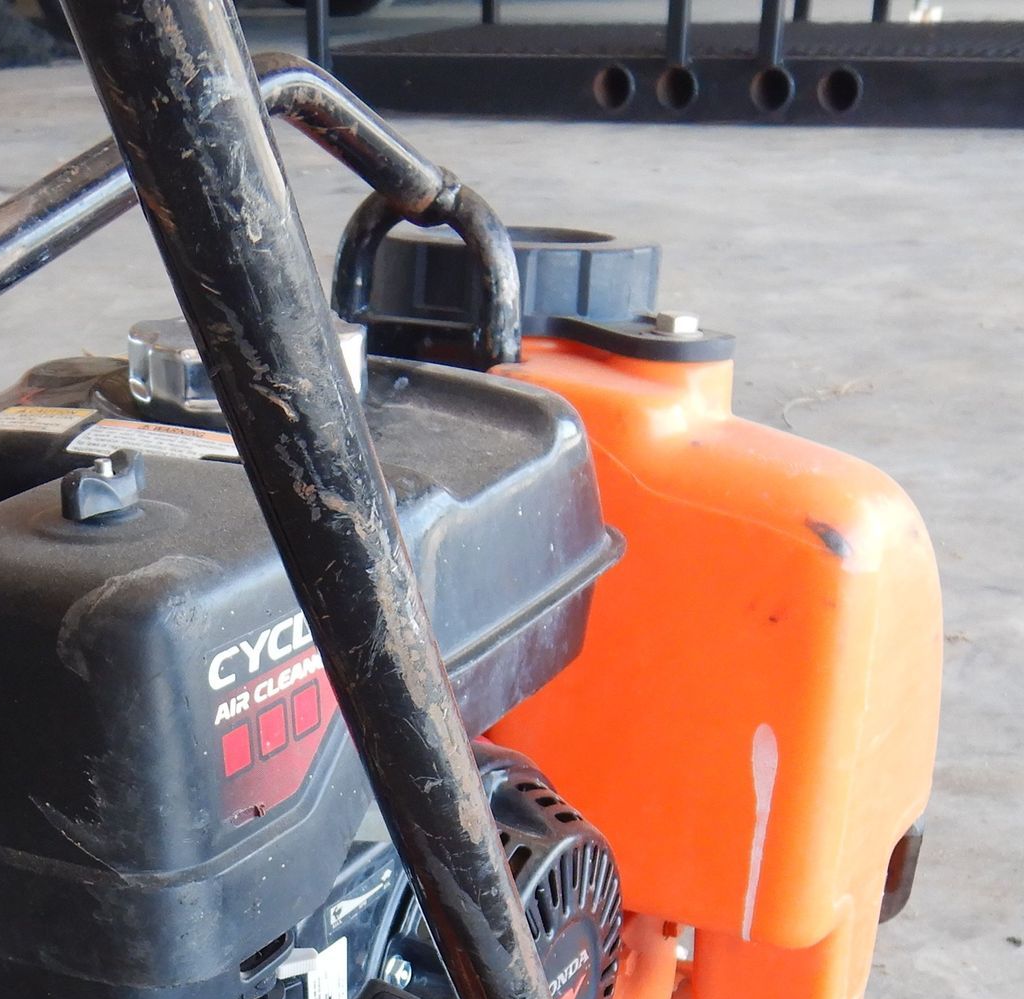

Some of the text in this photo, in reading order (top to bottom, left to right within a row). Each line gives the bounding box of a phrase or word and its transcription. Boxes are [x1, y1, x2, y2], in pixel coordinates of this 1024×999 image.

[209, 611, 314, 690] CYCL
[214, 654, 324, 726] AIR CLEAN
[549, 949, 589, 997] ONDA
